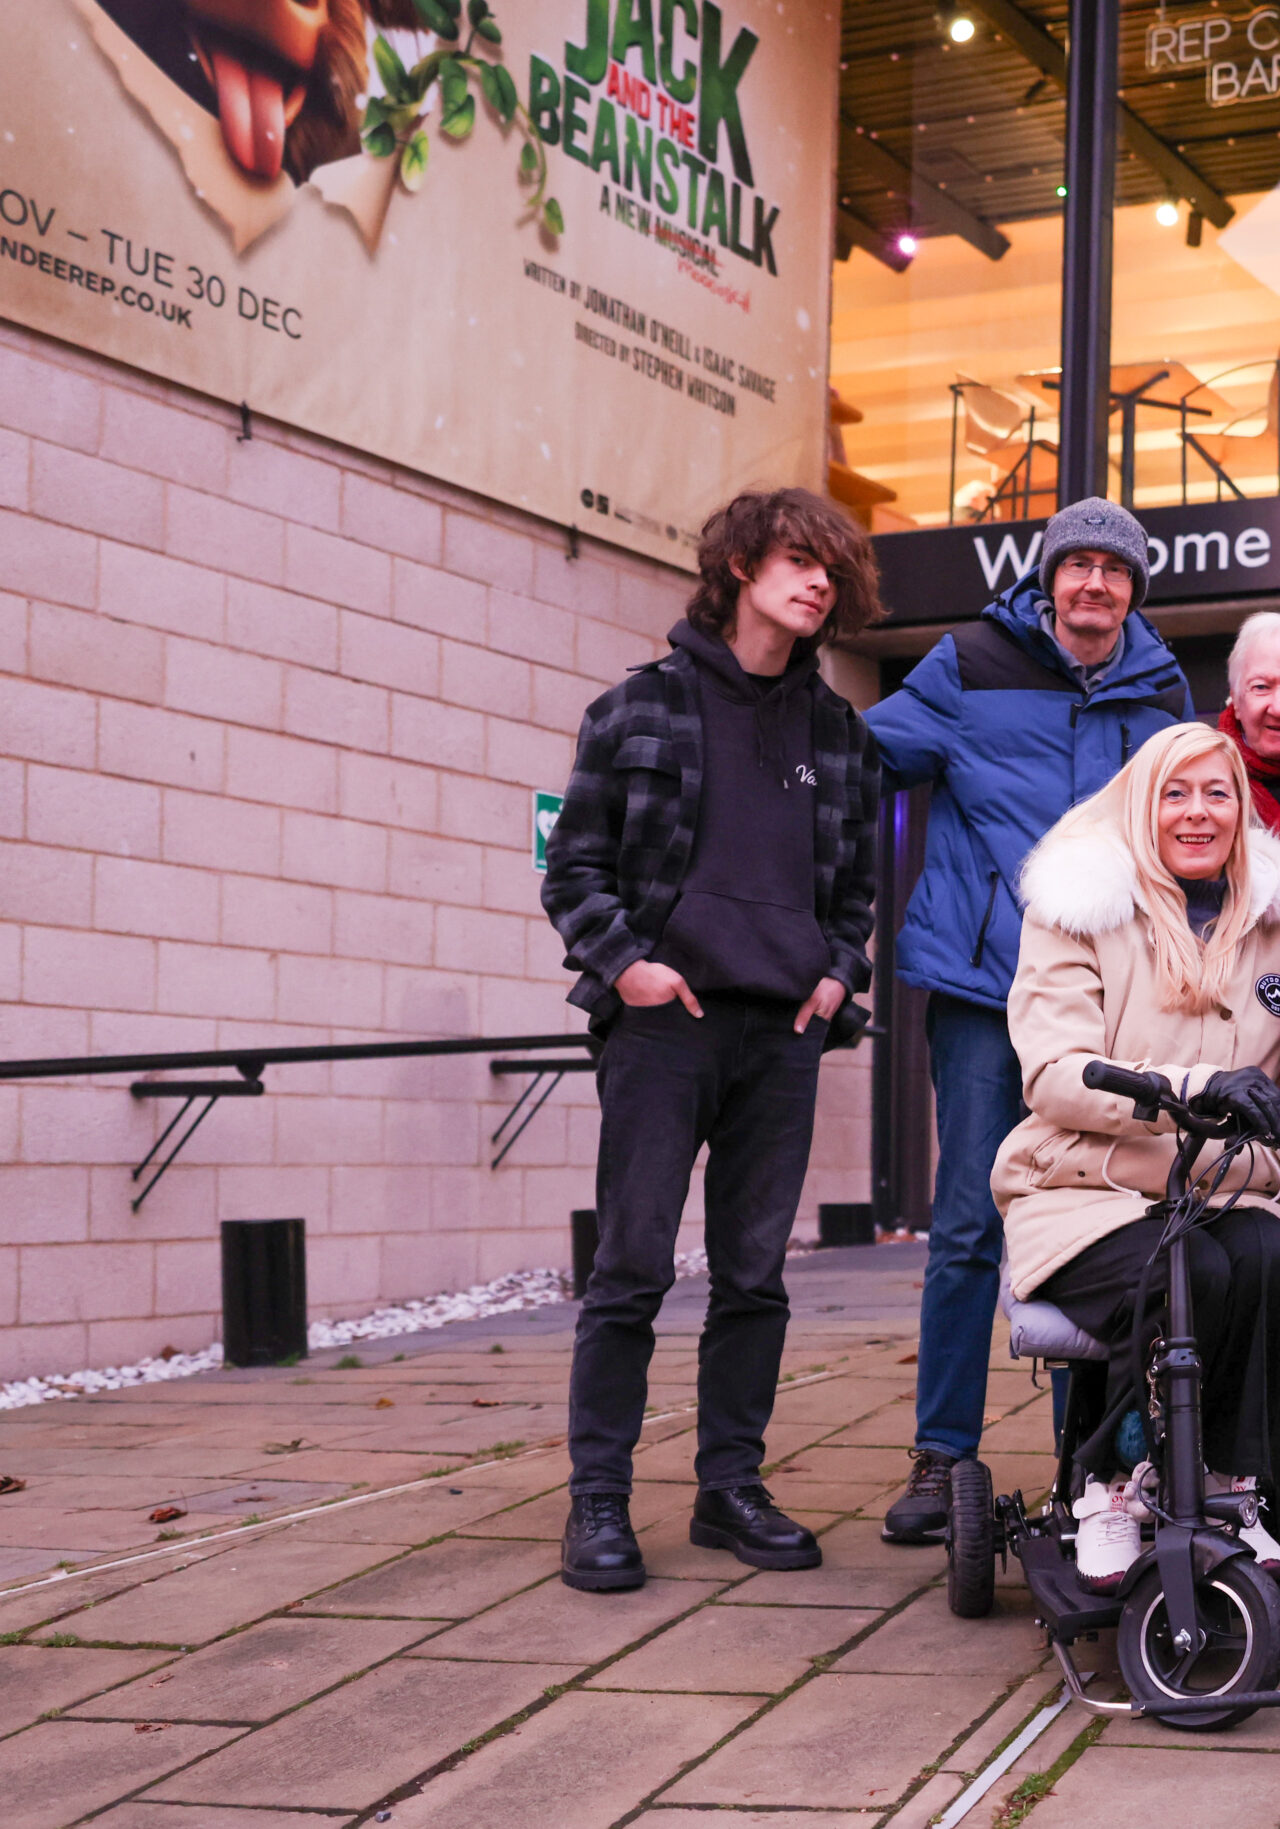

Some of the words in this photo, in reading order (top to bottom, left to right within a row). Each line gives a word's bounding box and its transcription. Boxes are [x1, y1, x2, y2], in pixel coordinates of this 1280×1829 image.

[1150, 18, 1232, 67] REP
[565, 0, 759, 188] JACK
[607, 63, 651, 121] AND
[657, 92, 696, 149] THE
[530, 54, 780, 277] BEANSTALK
[599, 184, 611, 216] A
[615, 192, 651, 238] NEW
[655, 215, 719, 278] MUSICAL
[0, 236, 193, 329] NDEEREP.CO.UK
[101, 229, 175, 288] TUE
[186, 266, 226, 308] 30
[238, 286, 303, 339] DEC
[523, 258, 566, 294] WRITTEN
[570, 280, 581, 300] BY
[584, 286, 647, 337] JONATHAN
[650, 319, 691, 362] O'NEILL
[702, 346, 735, 383] ISAAC
[738, 364, 776, 403] SAVAGE
[575, 321, 616, 357] DIRECTED
[619, 344, 630, 363] BY
[633, 347, 683, 392] STEPHEN
[687, 373, 736, 418] WHITSON
[973, 527, 1271, 590] Wome
